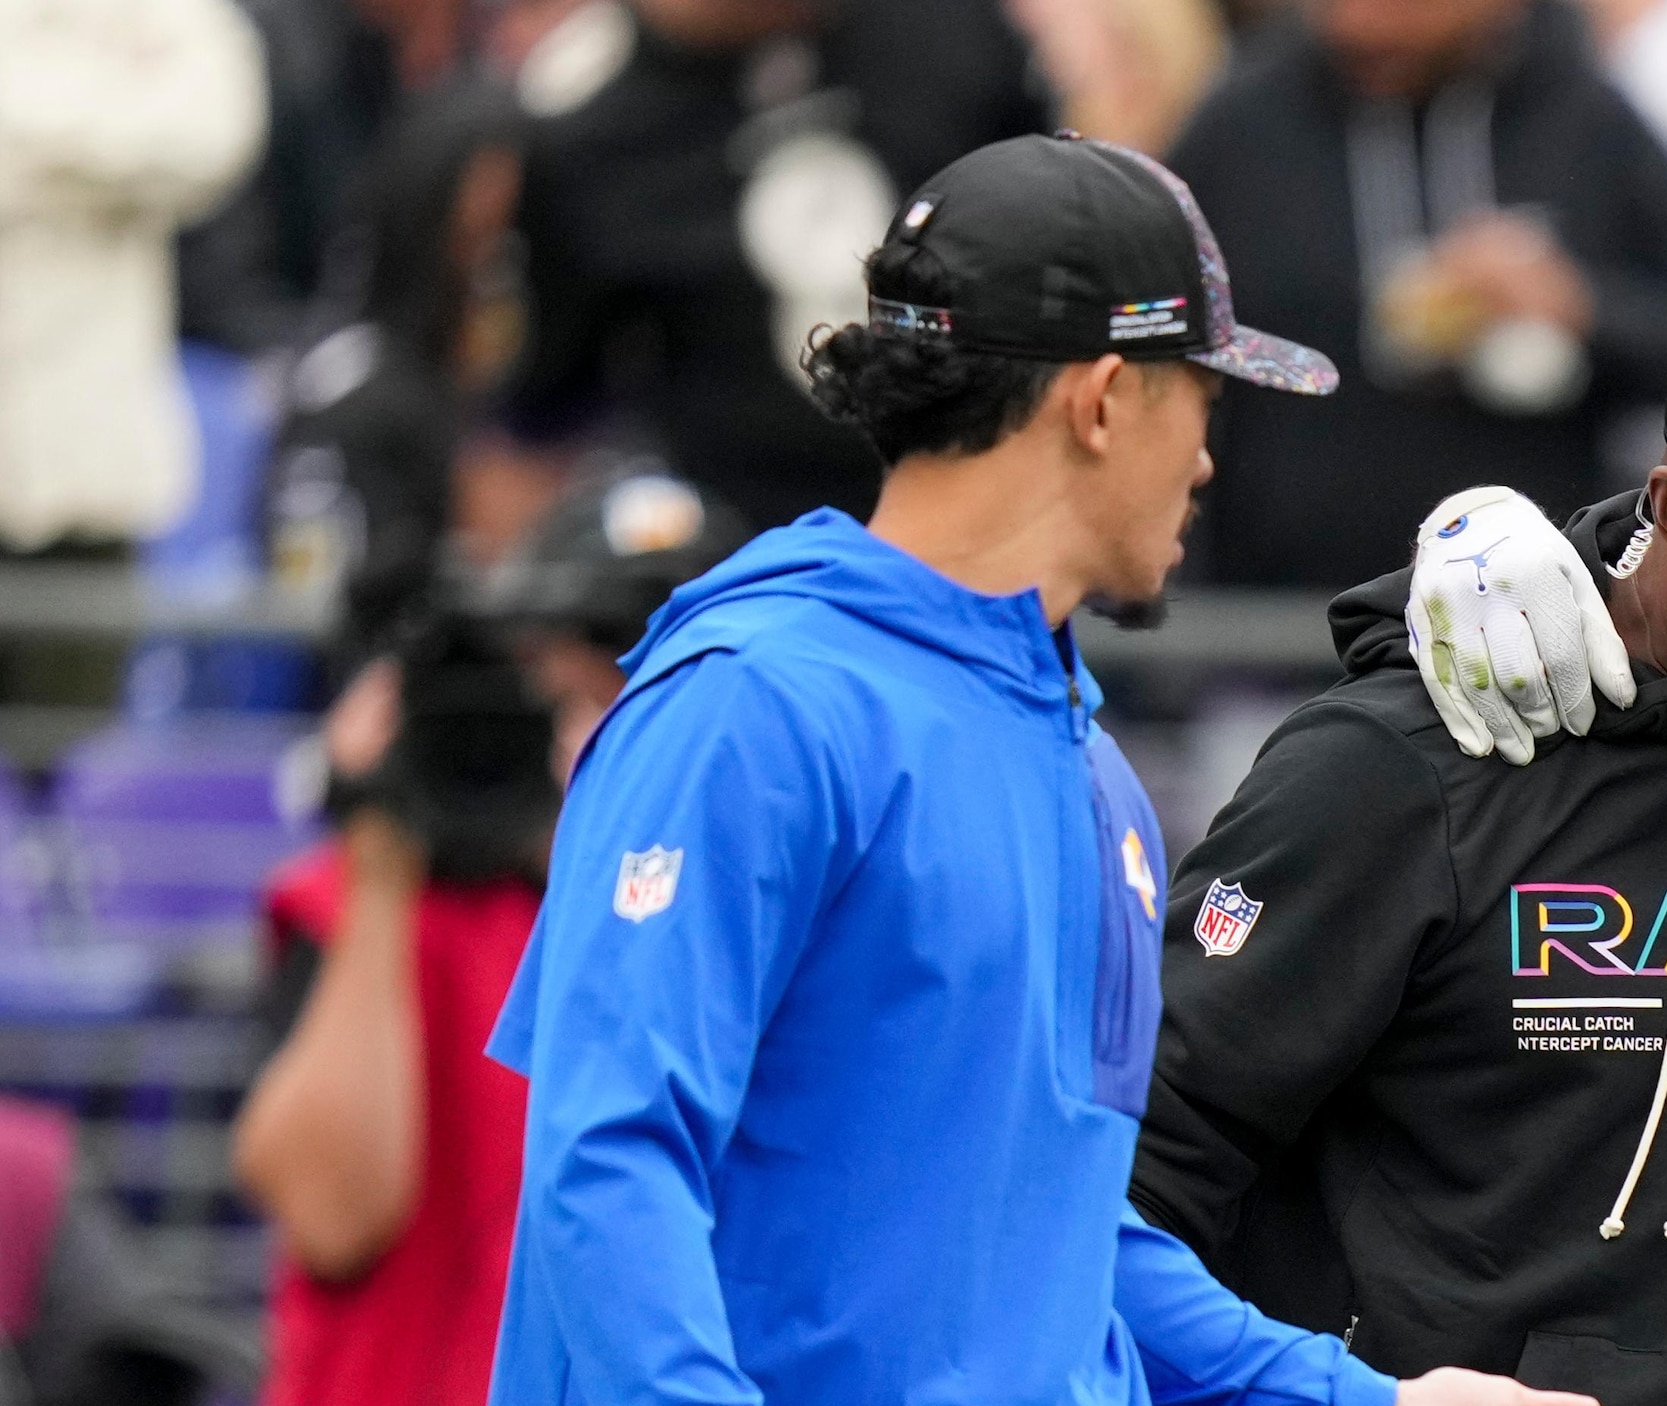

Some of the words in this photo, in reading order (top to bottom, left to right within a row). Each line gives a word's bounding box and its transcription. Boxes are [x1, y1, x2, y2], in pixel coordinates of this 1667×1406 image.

[1201, 907, 1241, 948] NFL
[1513, 1017, 1582, 1031] CRUCIAL
[1585, 1017, 1634, 1031] CATCH
[1603, 1037, 1663, 1051] CANCER
